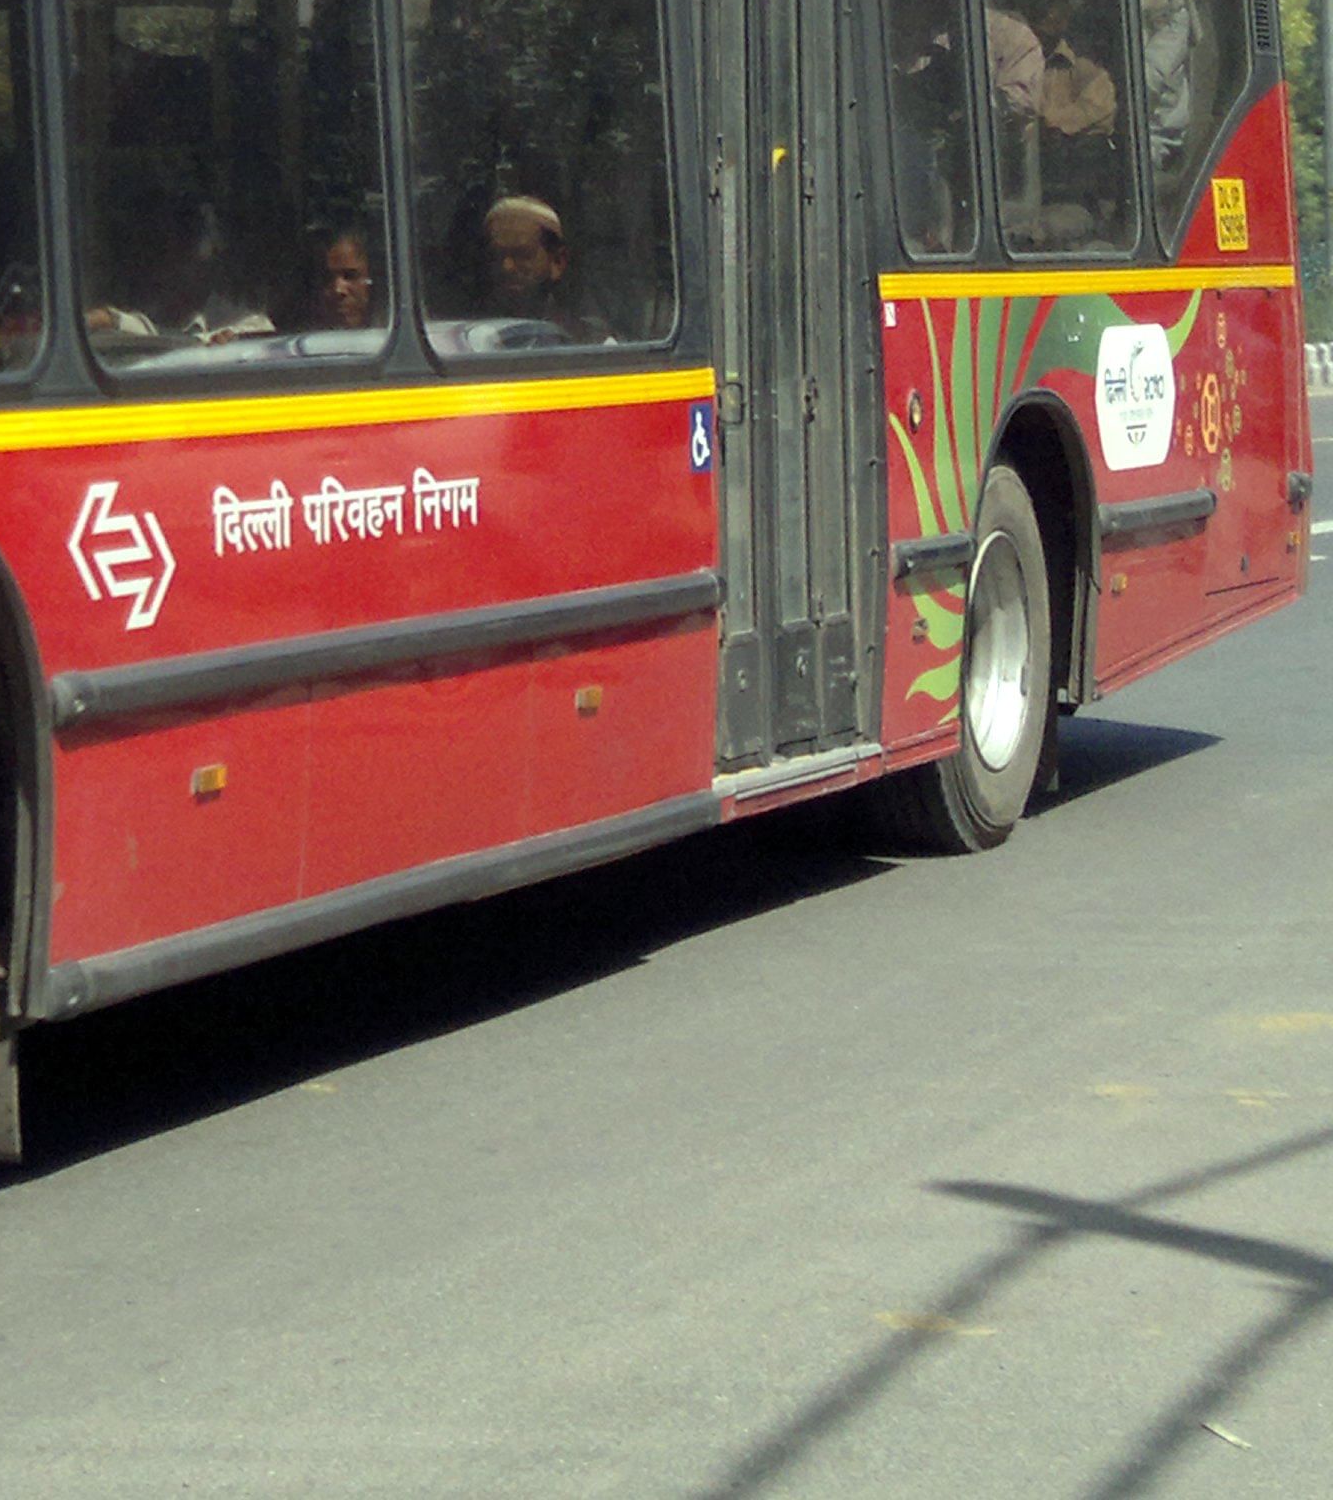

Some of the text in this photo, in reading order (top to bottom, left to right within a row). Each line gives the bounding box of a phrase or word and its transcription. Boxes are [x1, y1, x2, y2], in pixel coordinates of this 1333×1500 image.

[213, 467, 480, 557] दिल्ली परिवहन निगम
